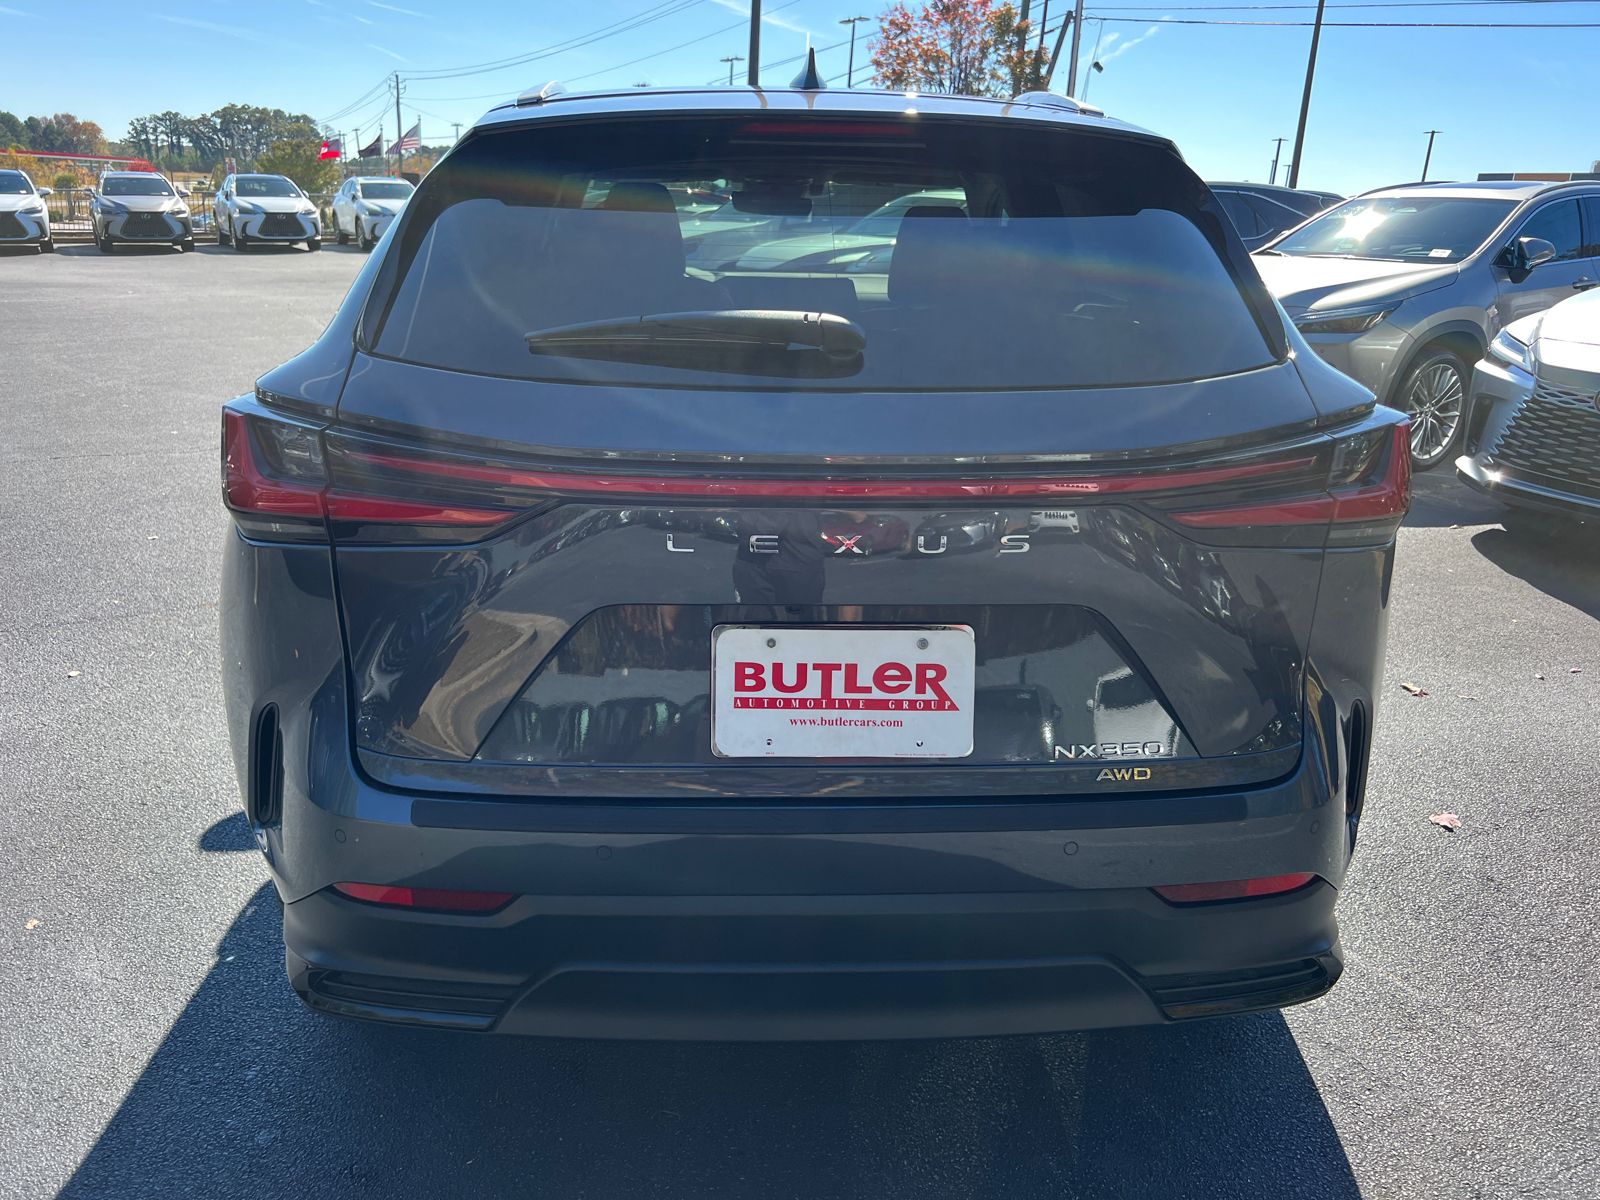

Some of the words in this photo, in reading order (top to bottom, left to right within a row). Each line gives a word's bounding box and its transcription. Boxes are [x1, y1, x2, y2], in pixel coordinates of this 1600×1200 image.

[666, 534, 1030, 554] LEXUS
[735, 698, 866, 709] AUTOMOTIVE
[888, 699, 952, 710] GROUP
[789, 716, 904, 728] www.butlercars.com
[1053, 741, 1165, 759] NX350
[1096, 767, 1152, 781] AWD
